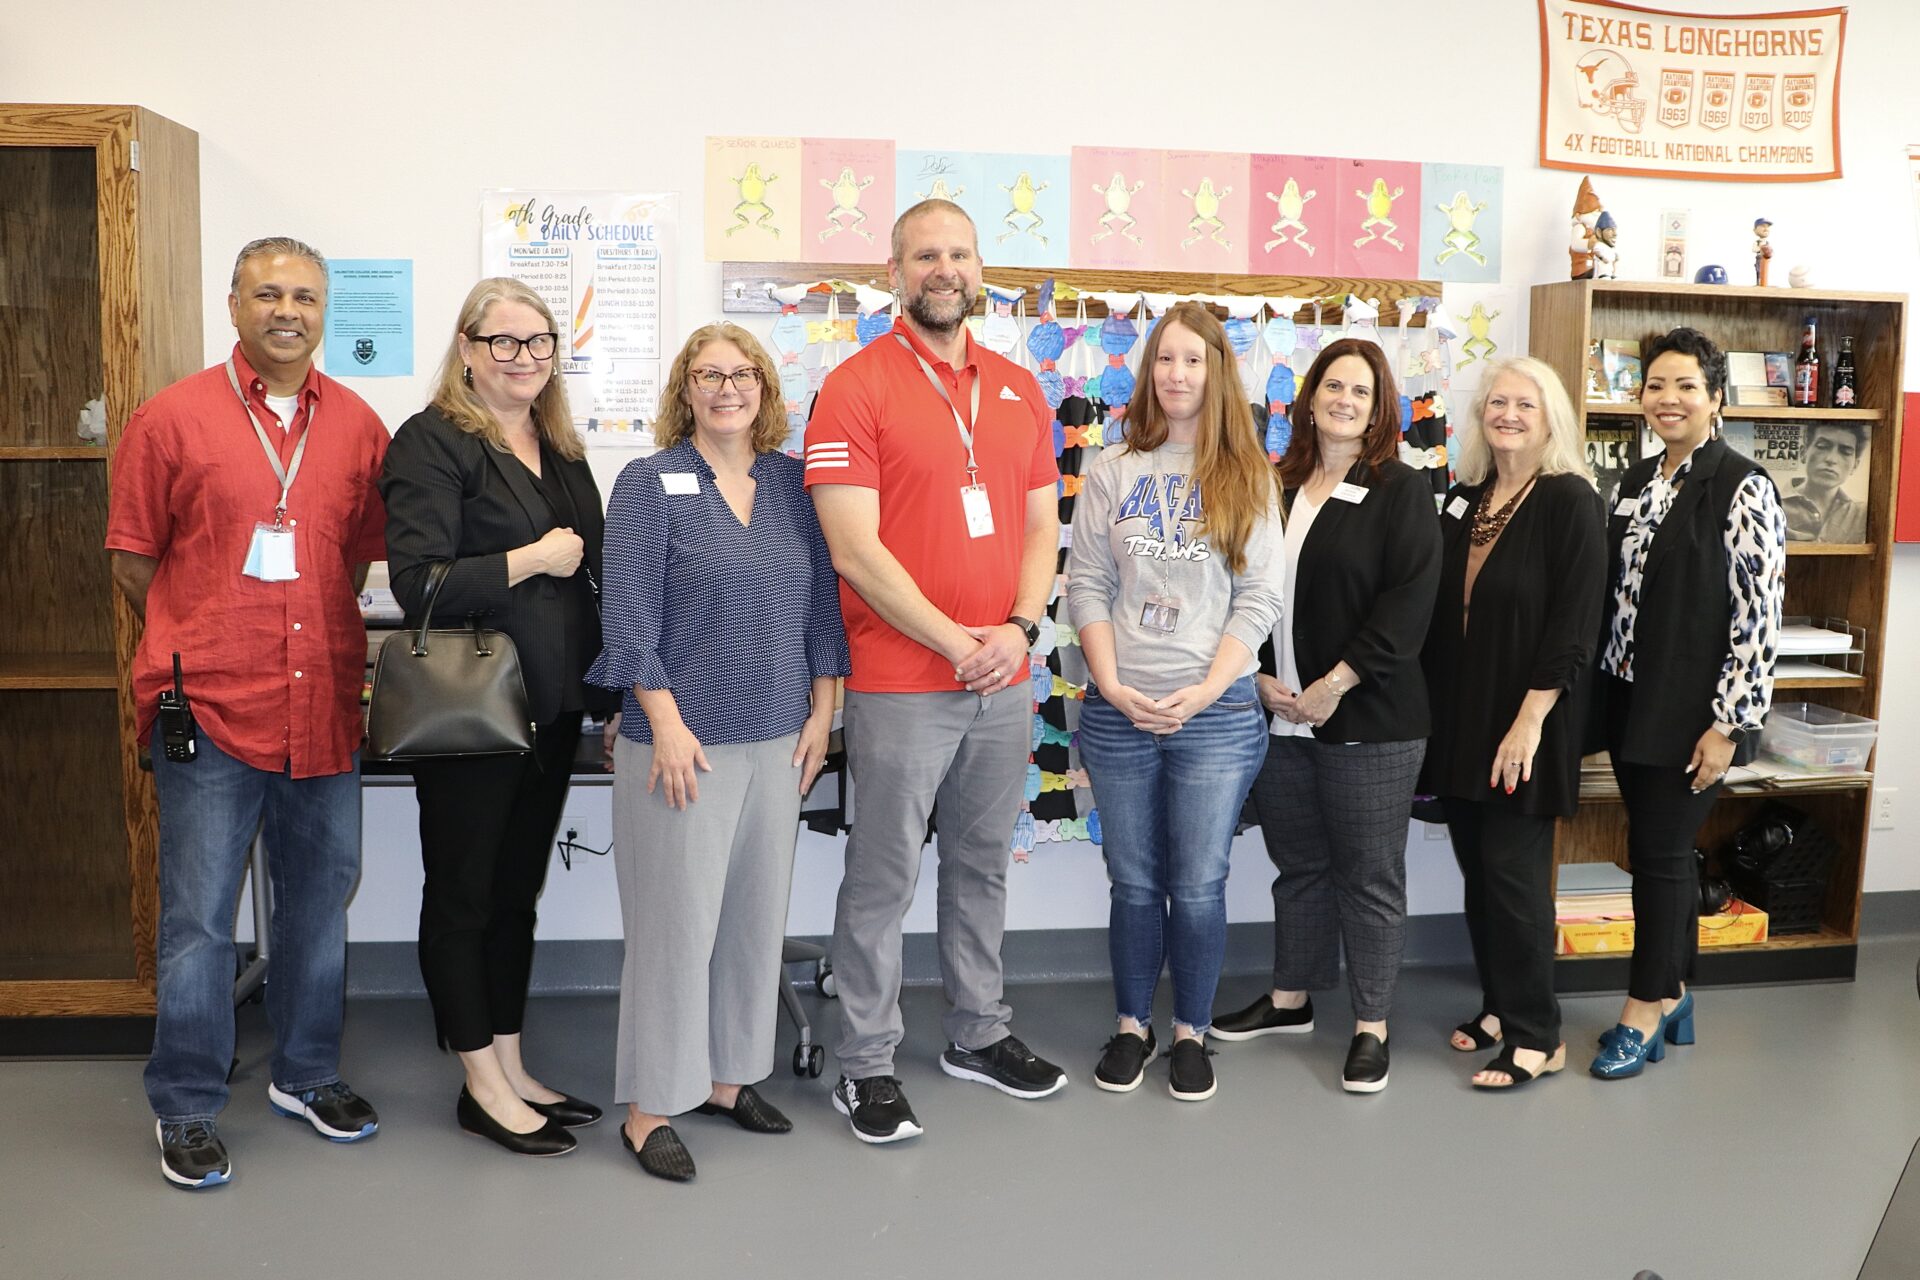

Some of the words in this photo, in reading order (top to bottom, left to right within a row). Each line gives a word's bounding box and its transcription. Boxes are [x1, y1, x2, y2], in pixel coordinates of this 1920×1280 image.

[1562, 11, 1653, 50] TEXAS
[1664, 25, 1823, 57] LONGHORNS
[1662, 108, 1686, 121] 1963
[1704, 110, 1727, 123] 1969
[1744, 112, 1768, 124] 1970
[1786, 111, 1813, 123] 2005
[1565, 134, 1584, 151] 4X
[1591, 136, 1658, 158] FOOTBALL
[1666, 143, 1732, 162] NATIONAL
[1739, 146, 1813, 163] CHAMPIONS
[541, 204, 592, 234] Grade
[588, 225, 654, 241] SCHEDULE
[1768, 440, 1799, 450] BOB
[1754, 449, 1799, 460] YLAN
[1123, 535, 1210, 562] TITANS
